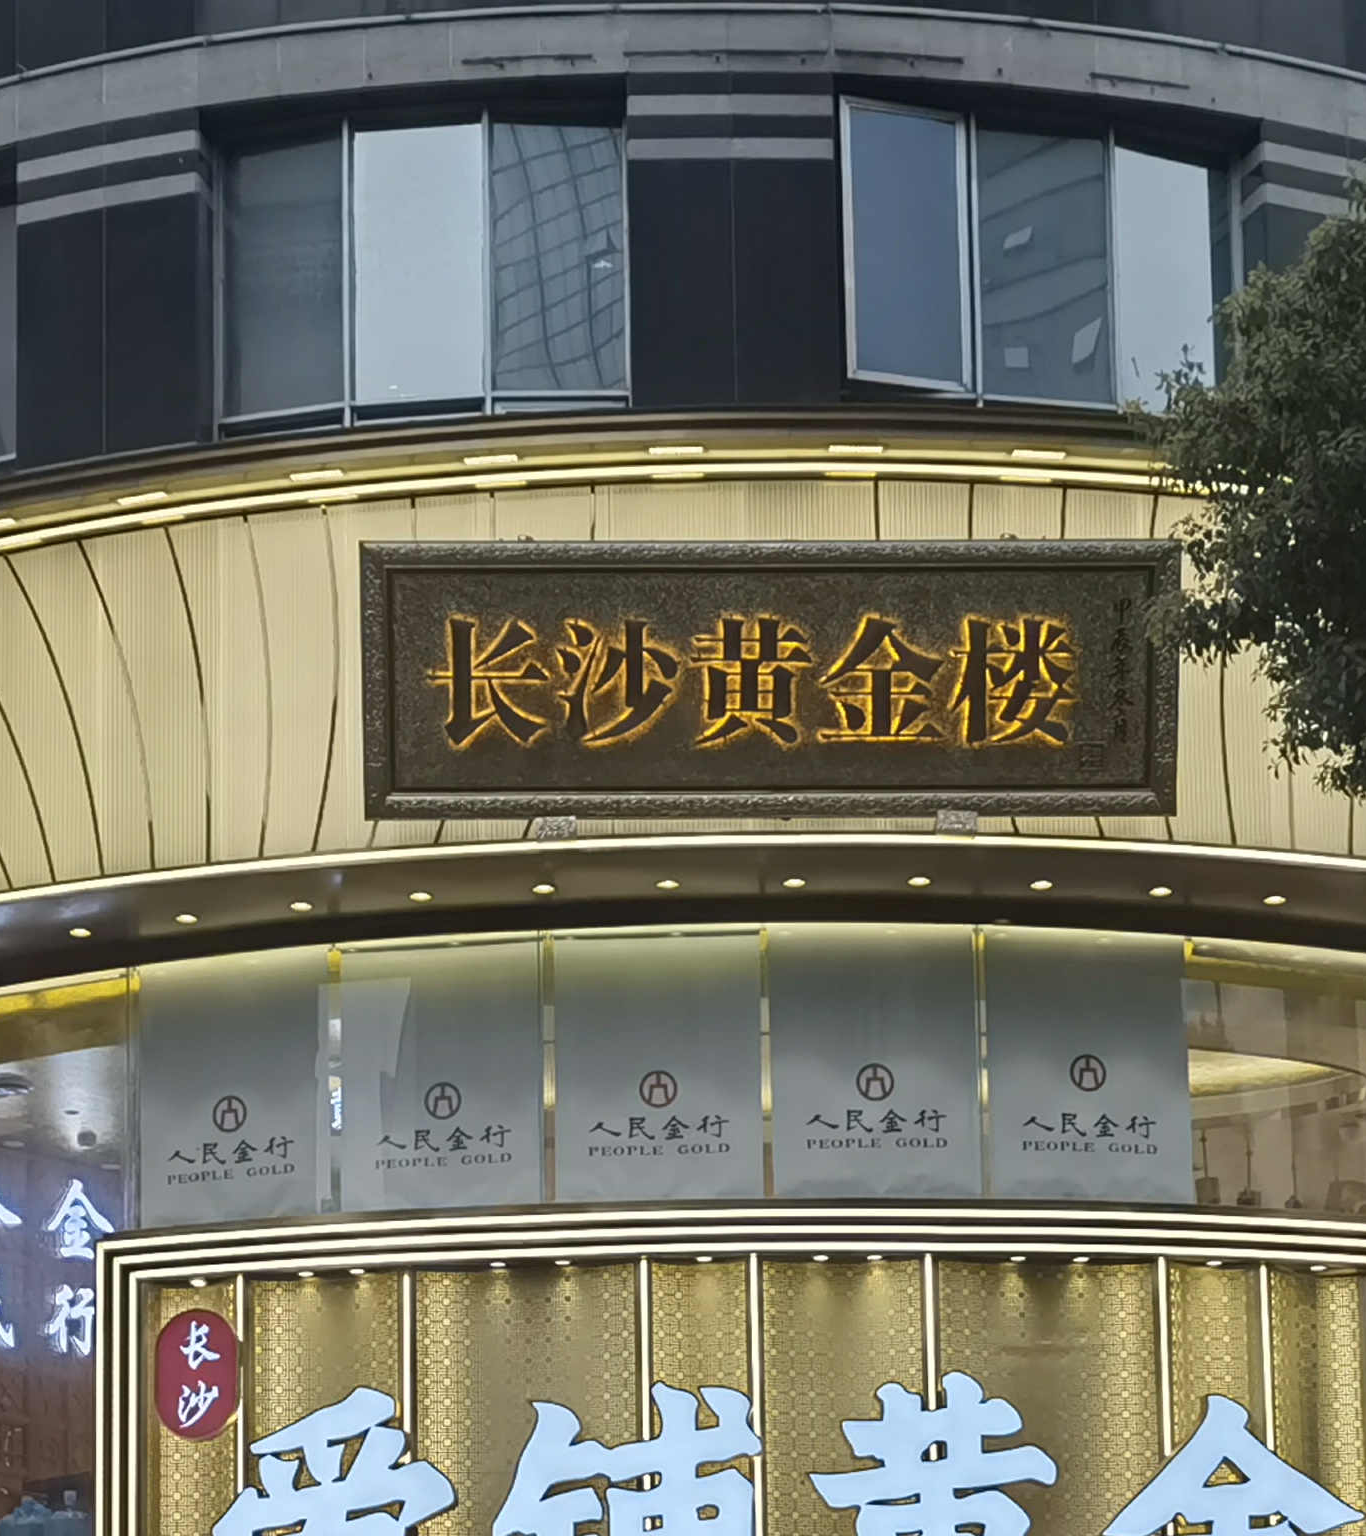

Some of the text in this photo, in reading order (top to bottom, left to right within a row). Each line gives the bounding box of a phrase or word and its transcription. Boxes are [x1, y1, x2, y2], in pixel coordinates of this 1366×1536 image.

[428, 614, 1078, 748] 长沙黄金楼
[588, 1114, 730, 1141] 人民金行
[805, 1108, 947, 1134] 人民金行
[1022, 1112, 1156, 1140] 人民金行
[167, 1136, 295, 1165] 人民金行
[376, 1125, 512, 1153] 人民金行
[588, 1142, 730, 1157] PEOPLE GOLD
[806, 1137, 947, 1149] PEOPLE GOLD
[1022, 1140, 1157, 1154] PEOPLE GOLD
[167, 1163, 295, 1185] PEOPLE GOLD
[375, 1152, 512, 1170] PEOPLE GOLD
[179, 1320, 221, 1429] 长沙
